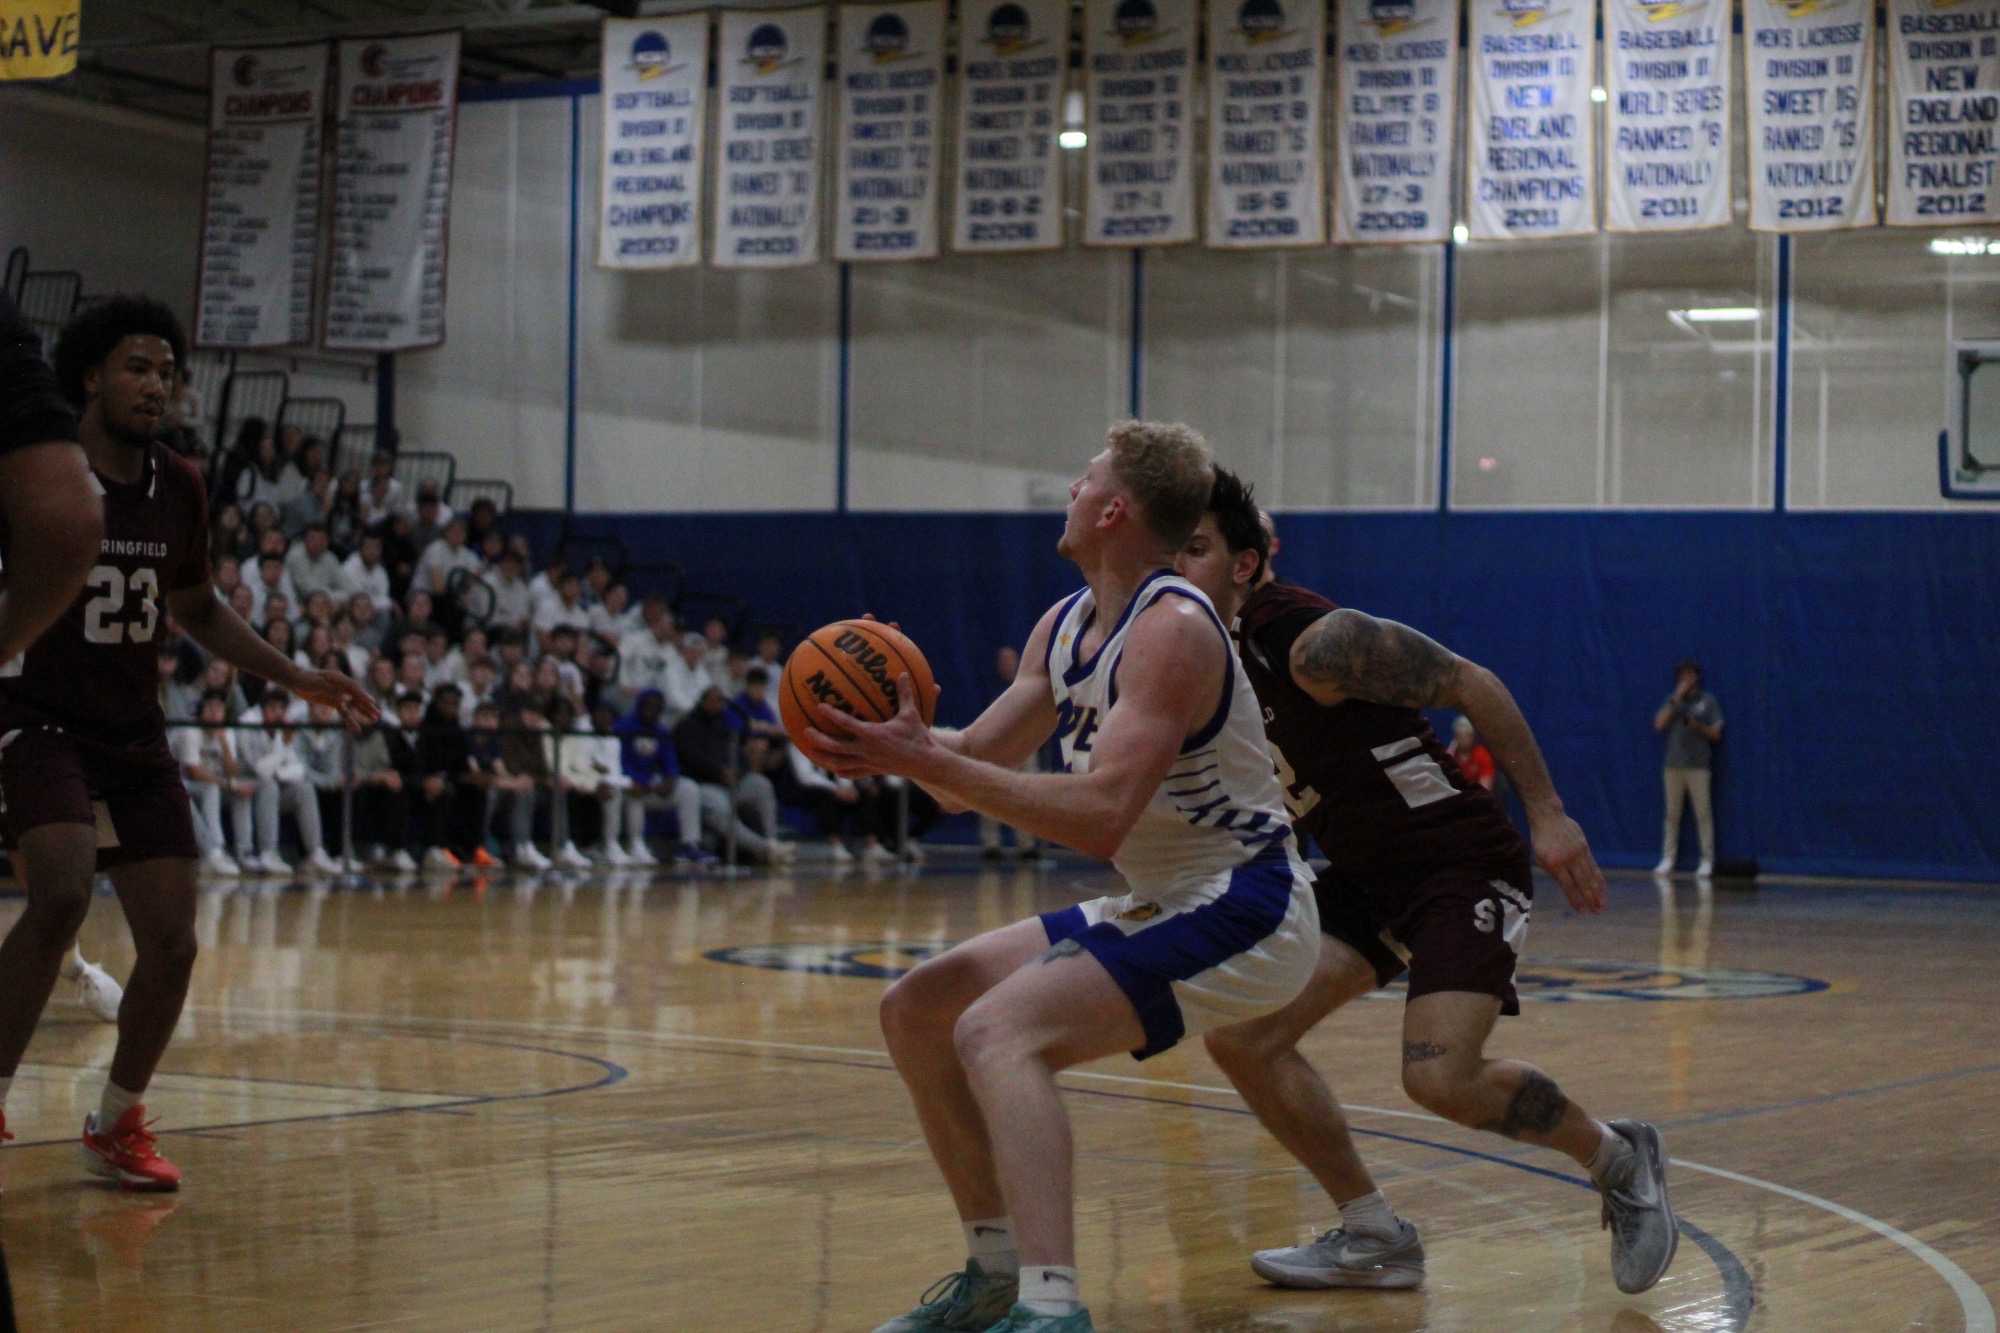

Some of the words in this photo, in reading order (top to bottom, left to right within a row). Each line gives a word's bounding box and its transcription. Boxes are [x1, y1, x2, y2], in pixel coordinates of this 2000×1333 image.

[1798, 22, 1863, 48] LACROSSE
[1900, 11, 2000, 35] BASEBALL
[1618, 27, 1715, 49] BASEBALL
[1908, 41, 1973, 60] DIVISION
[1628, 61, 1688, 79] DIVISION
[1766, 59, 1828, 78] DIVISION
[1926, 65, 1979, 91] NEW
[1619, 91, 1668, 115] WORLD
[1673, 85, 1723, 113] SERIES
[1764, 88, 1827, 114] SWEET
[1907, 96, 1998, 124] ENGLAND
[1618, 126, 1692, 151] RANKED
[1763, 124, 1823, 151] RANKED
[1904, 128, 2000, 157] REGIONAL
[1766, 160, 1854, 187] NATIONALLY
[1905, 160, 1994, 188] FINALIST
[1480, 175, 1583, 202] CHAMPIONS
[1641, 197, 1697, 217] 2011
[1778, 197, 1843, 218] 2012
[1916, 194, 1986, 215] 2012
[101, 540, 167, 557] RINGFIELD
[84, 565, 159, 643] 23
[1473, 898, 1496, 933] S
